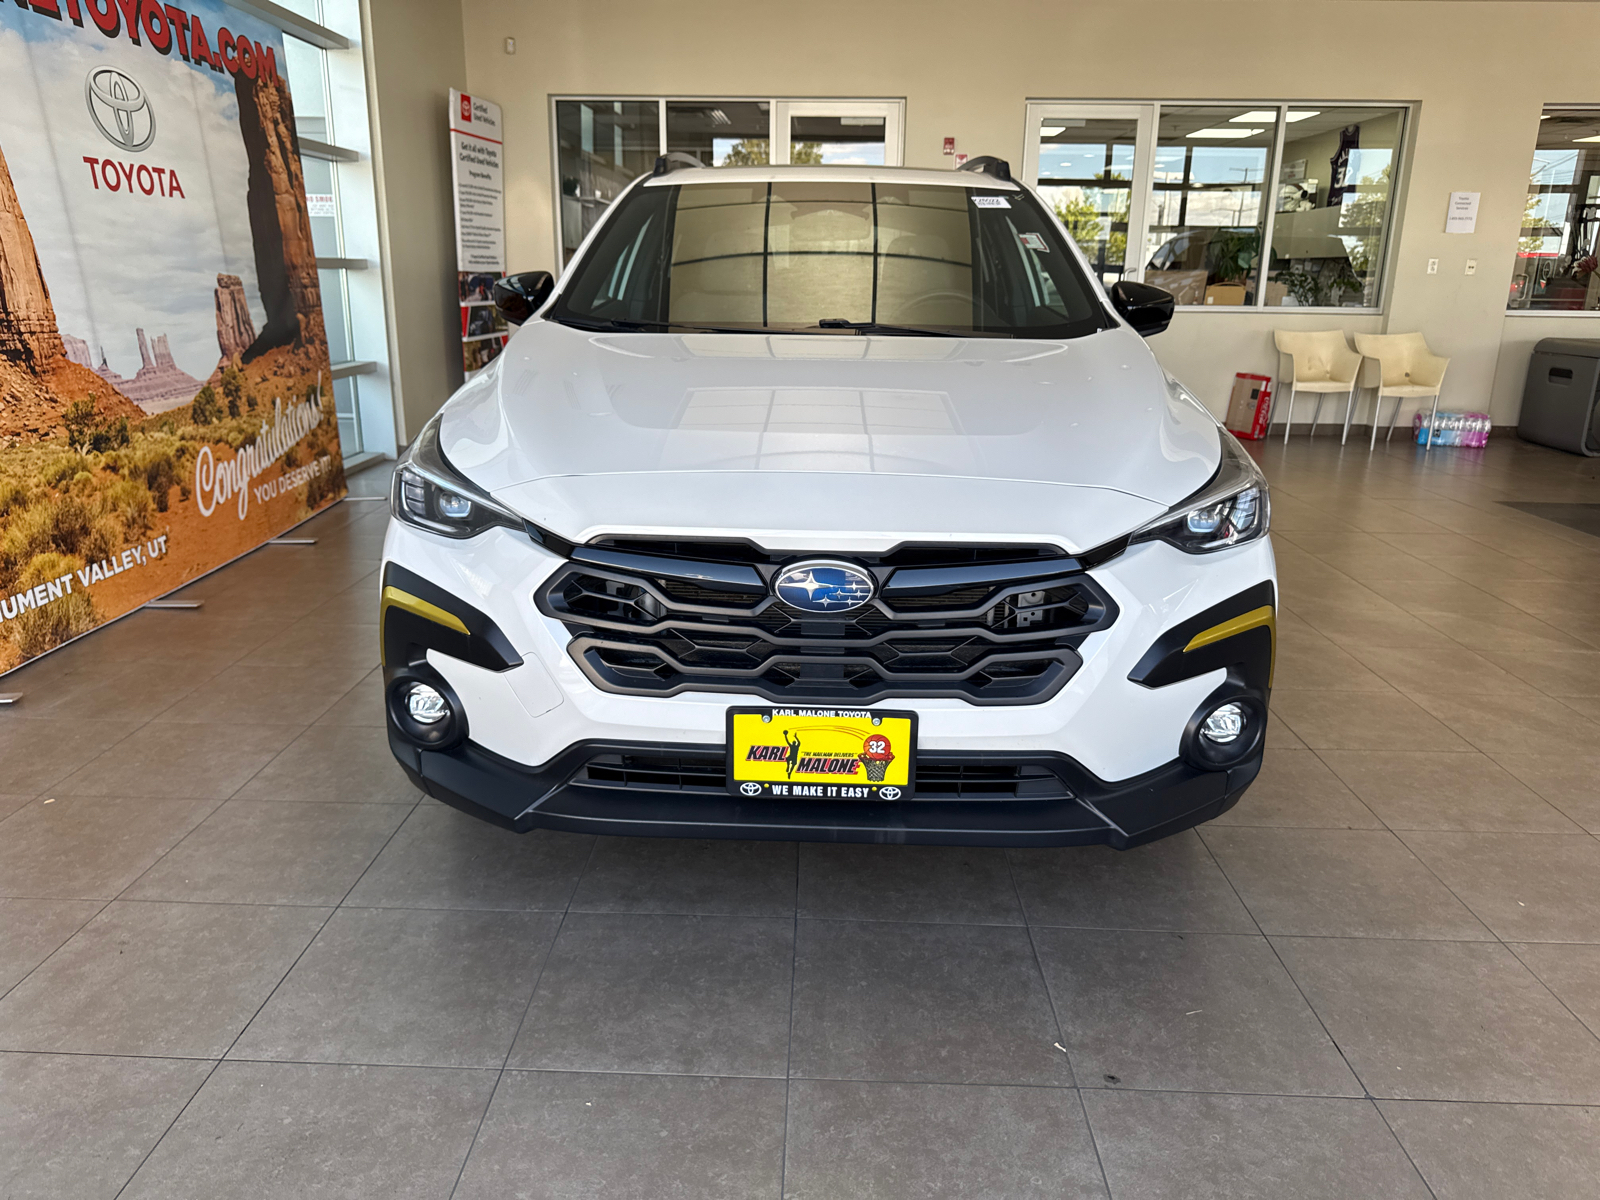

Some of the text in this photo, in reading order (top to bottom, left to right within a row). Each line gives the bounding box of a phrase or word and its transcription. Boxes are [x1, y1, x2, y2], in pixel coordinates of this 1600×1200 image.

[83, 156, 185, 199] TOYOTA
[195, 369, 324, 520] Congratulations!
[253, 478, 278, 505] YOU
[278, 460, 321, 494] DESERVE
[0, 535, 167, 623] UMENT VALLEY, UT
[772, 709, 872, 719] KARL MALONE TOYOTA
[746, 745, 789, 762] KARL
[869, 741, 886, 754] 32
[796, 757, 860, 775] MALONE
[772, 785, 869, 798] WE MAKE IT EASY
